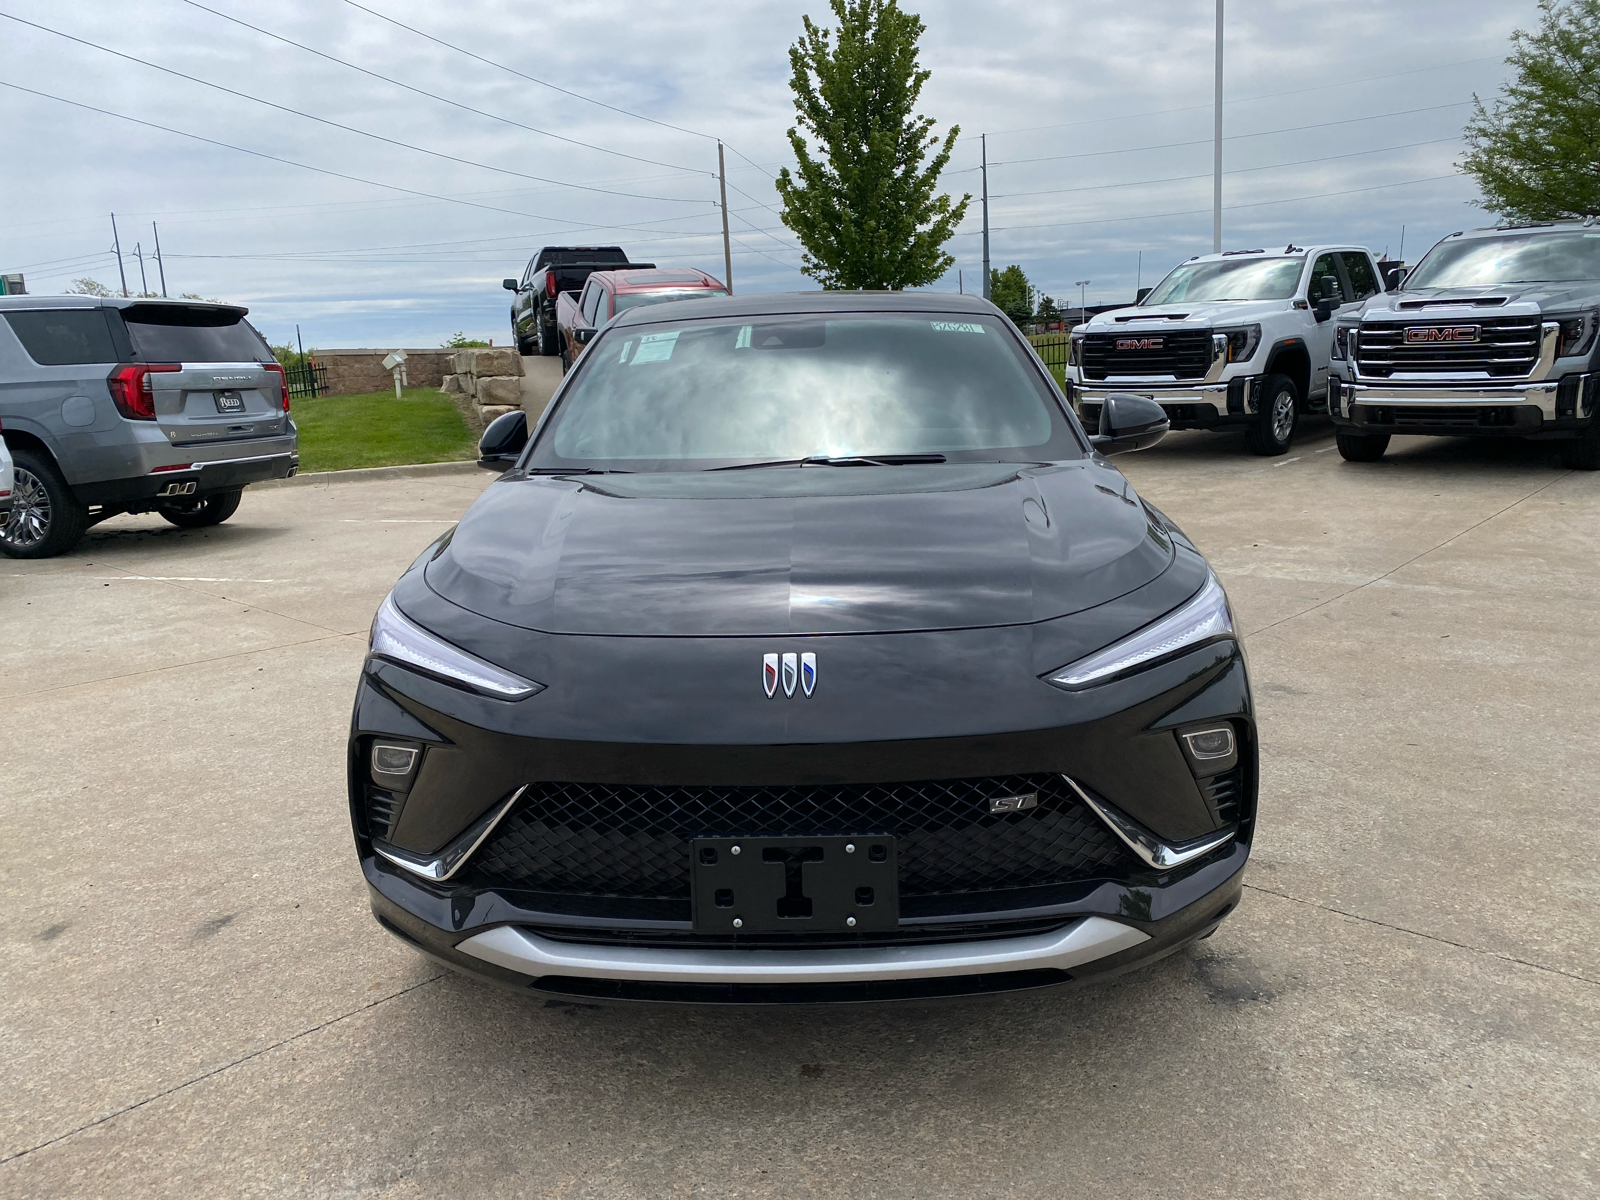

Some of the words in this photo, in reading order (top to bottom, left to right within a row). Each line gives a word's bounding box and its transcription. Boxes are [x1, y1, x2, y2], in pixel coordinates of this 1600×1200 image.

[1408, 327, 1475, 341] GMC
[1116, 339, 1163, 349] GMC
[991, 794, 1034, 812] ST
